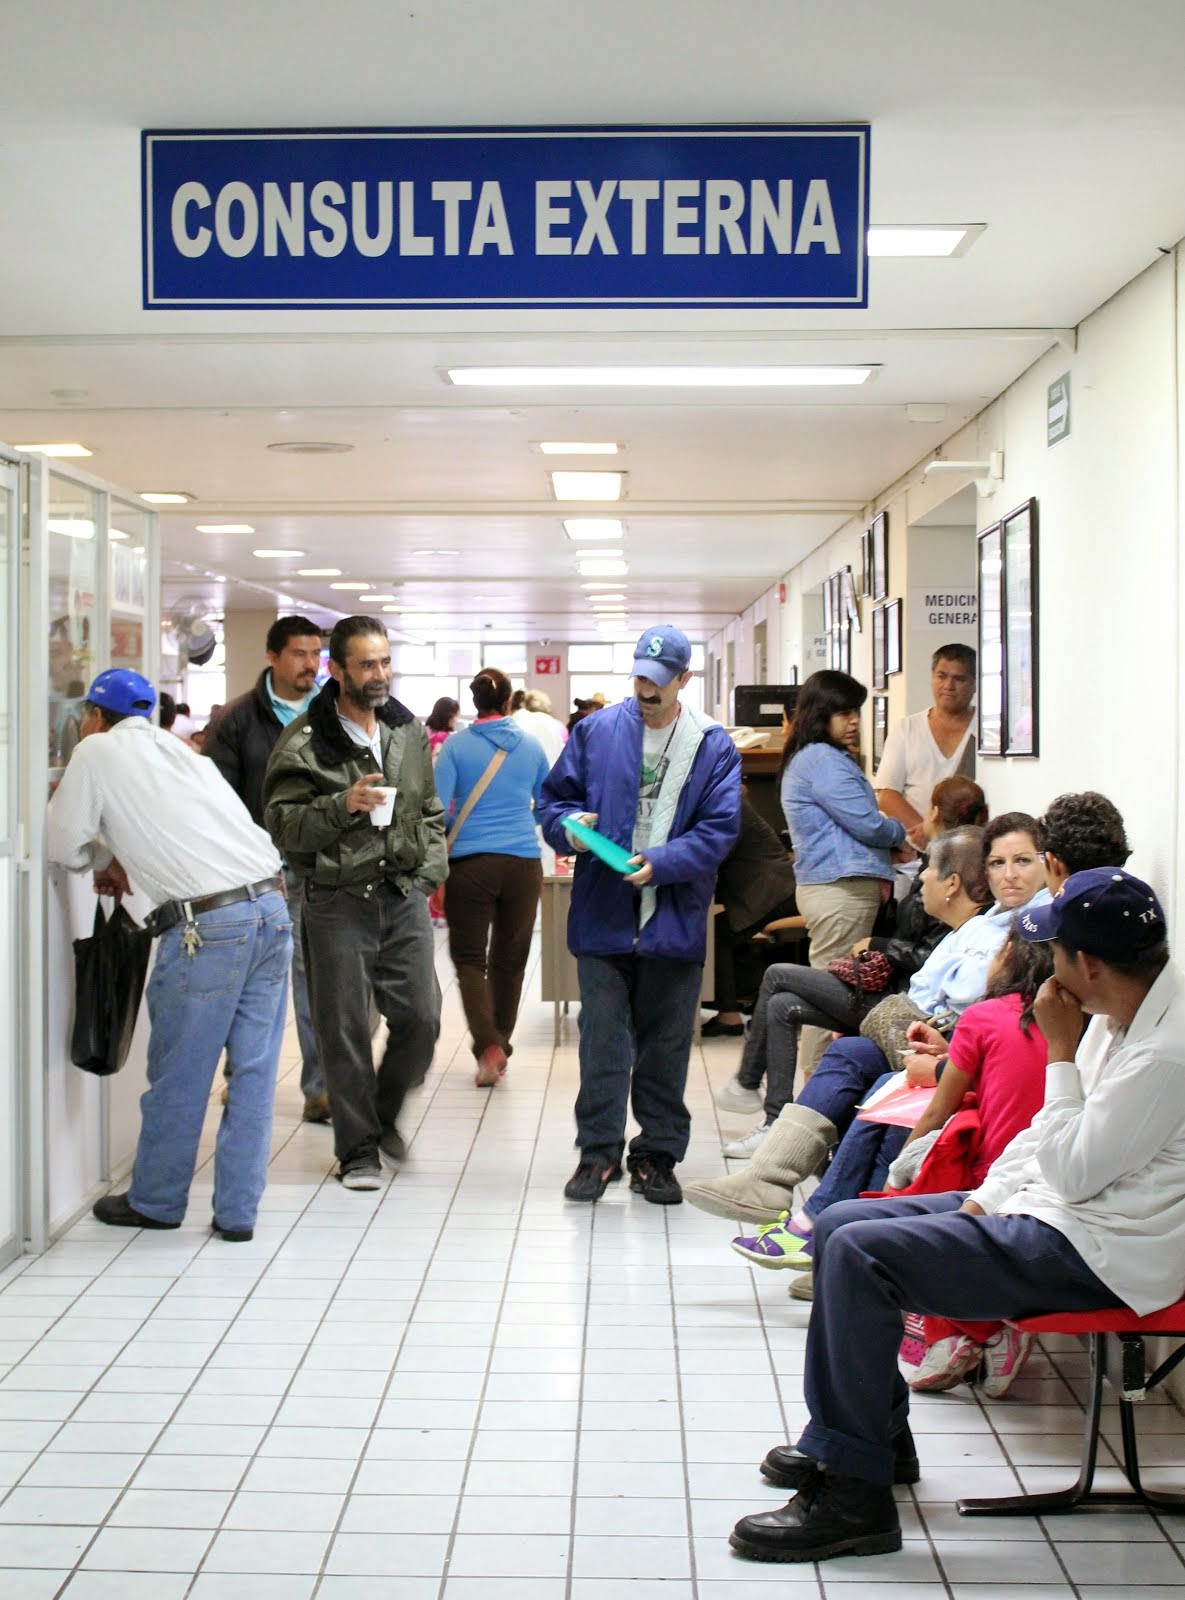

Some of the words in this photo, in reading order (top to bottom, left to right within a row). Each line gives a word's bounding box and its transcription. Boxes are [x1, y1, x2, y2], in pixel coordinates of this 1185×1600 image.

[171, 181, 514, 257] CONSULTA
[535, 179, 841, 255] EXTERNA
[928, 612, 976, 625] GENERA
[645, 636, 664, 657] S
[1022, 913, 1038, 933] TEXAS
[1138, 907, 1157, 924] TX
